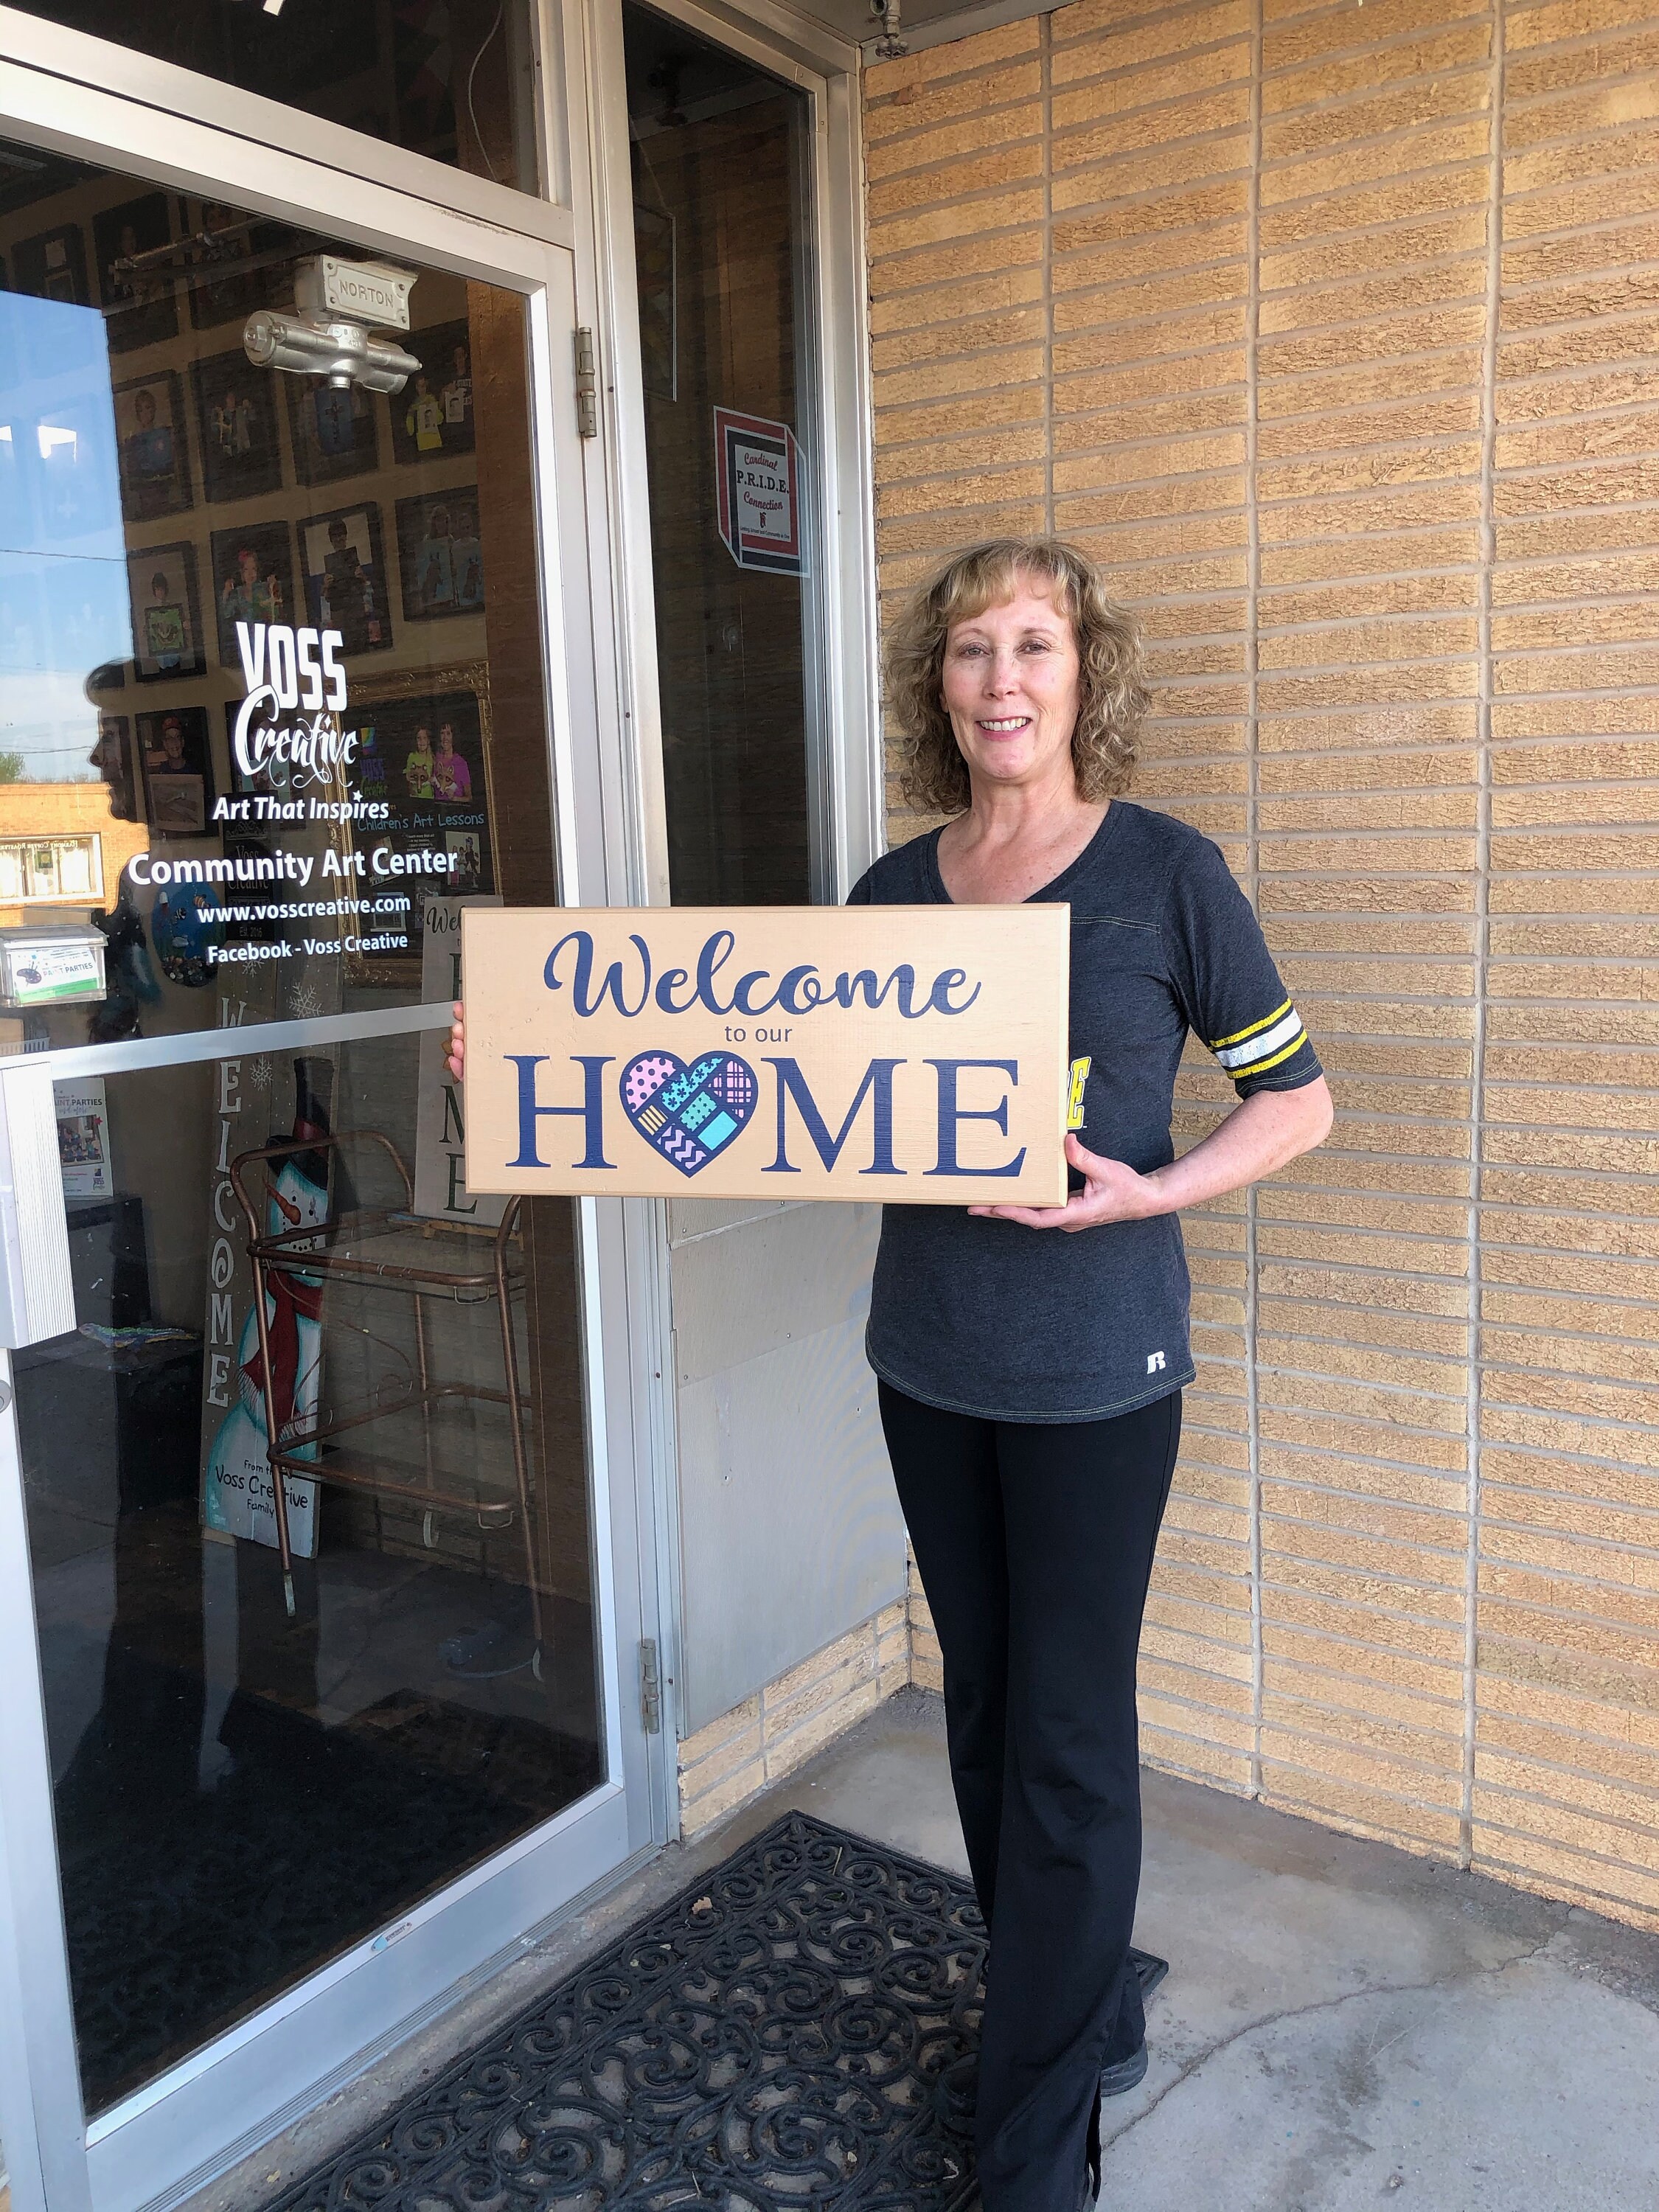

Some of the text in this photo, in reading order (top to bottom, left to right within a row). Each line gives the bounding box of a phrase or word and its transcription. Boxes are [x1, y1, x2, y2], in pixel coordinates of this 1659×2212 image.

[338, 279, 394, 308] NORTON
[744, 452, 778, 471] Cardinal
[736, 470, 790, 494] P.R.I.D.E.
[743, 491, 784, 510] Connection
[236, 622, 347, 712] VOSS
[235, 684, 359, 788] Creative
[212, 790, 389, 825] Art That Inspires
[358, 813, 484, 831] Children's Art Lessons
[128, 847, 458, 887] Community Art Center
[197, 896, 411, 923] www.vosscreative.com
[208, 940, 293, 964] Facebook
[303, 938, 341, 956] Voss
[344, 933, 408, 952] Creative
[65, 962, 94, 973] PARTIES
[543, 931, 981, 1019] Welcome
[725, 1026, 793, 1043] to our
[244, 1460, 263, 1473] From
[215, 1464, 308, 1508] Voss Cretive
[247, 1498, 276, 1518] Family
